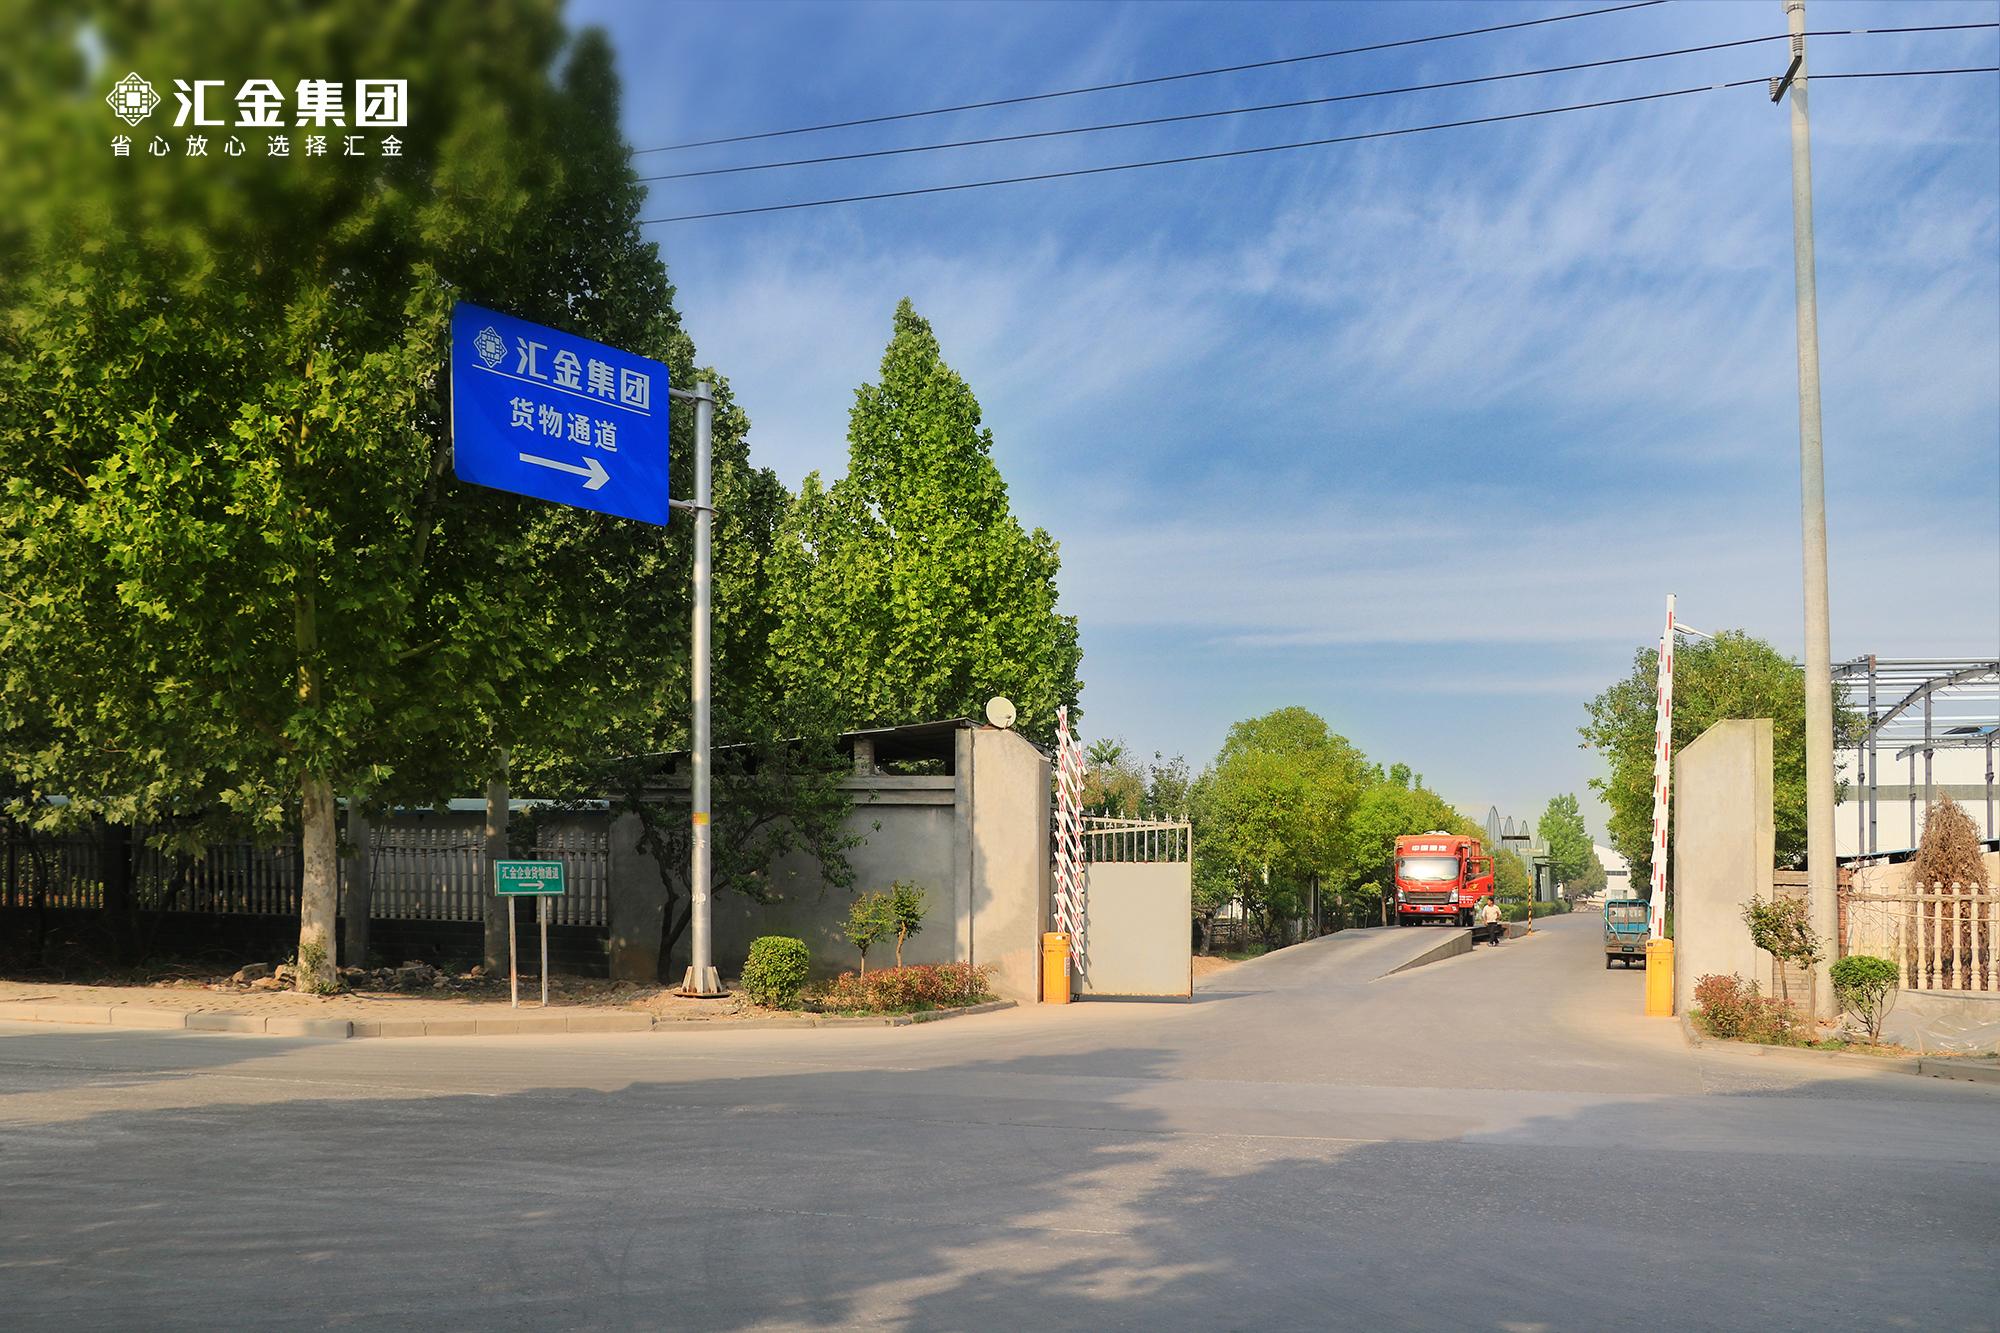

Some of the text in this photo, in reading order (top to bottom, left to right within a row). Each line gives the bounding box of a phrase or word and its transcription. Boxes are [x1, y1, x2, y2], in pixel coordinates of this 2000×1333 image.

[516, 336, 650, 410] 汇金集团
[509, 396, 618, 453] 货物通道
[502, 866, 559, 880] 汇金企业货物通道
